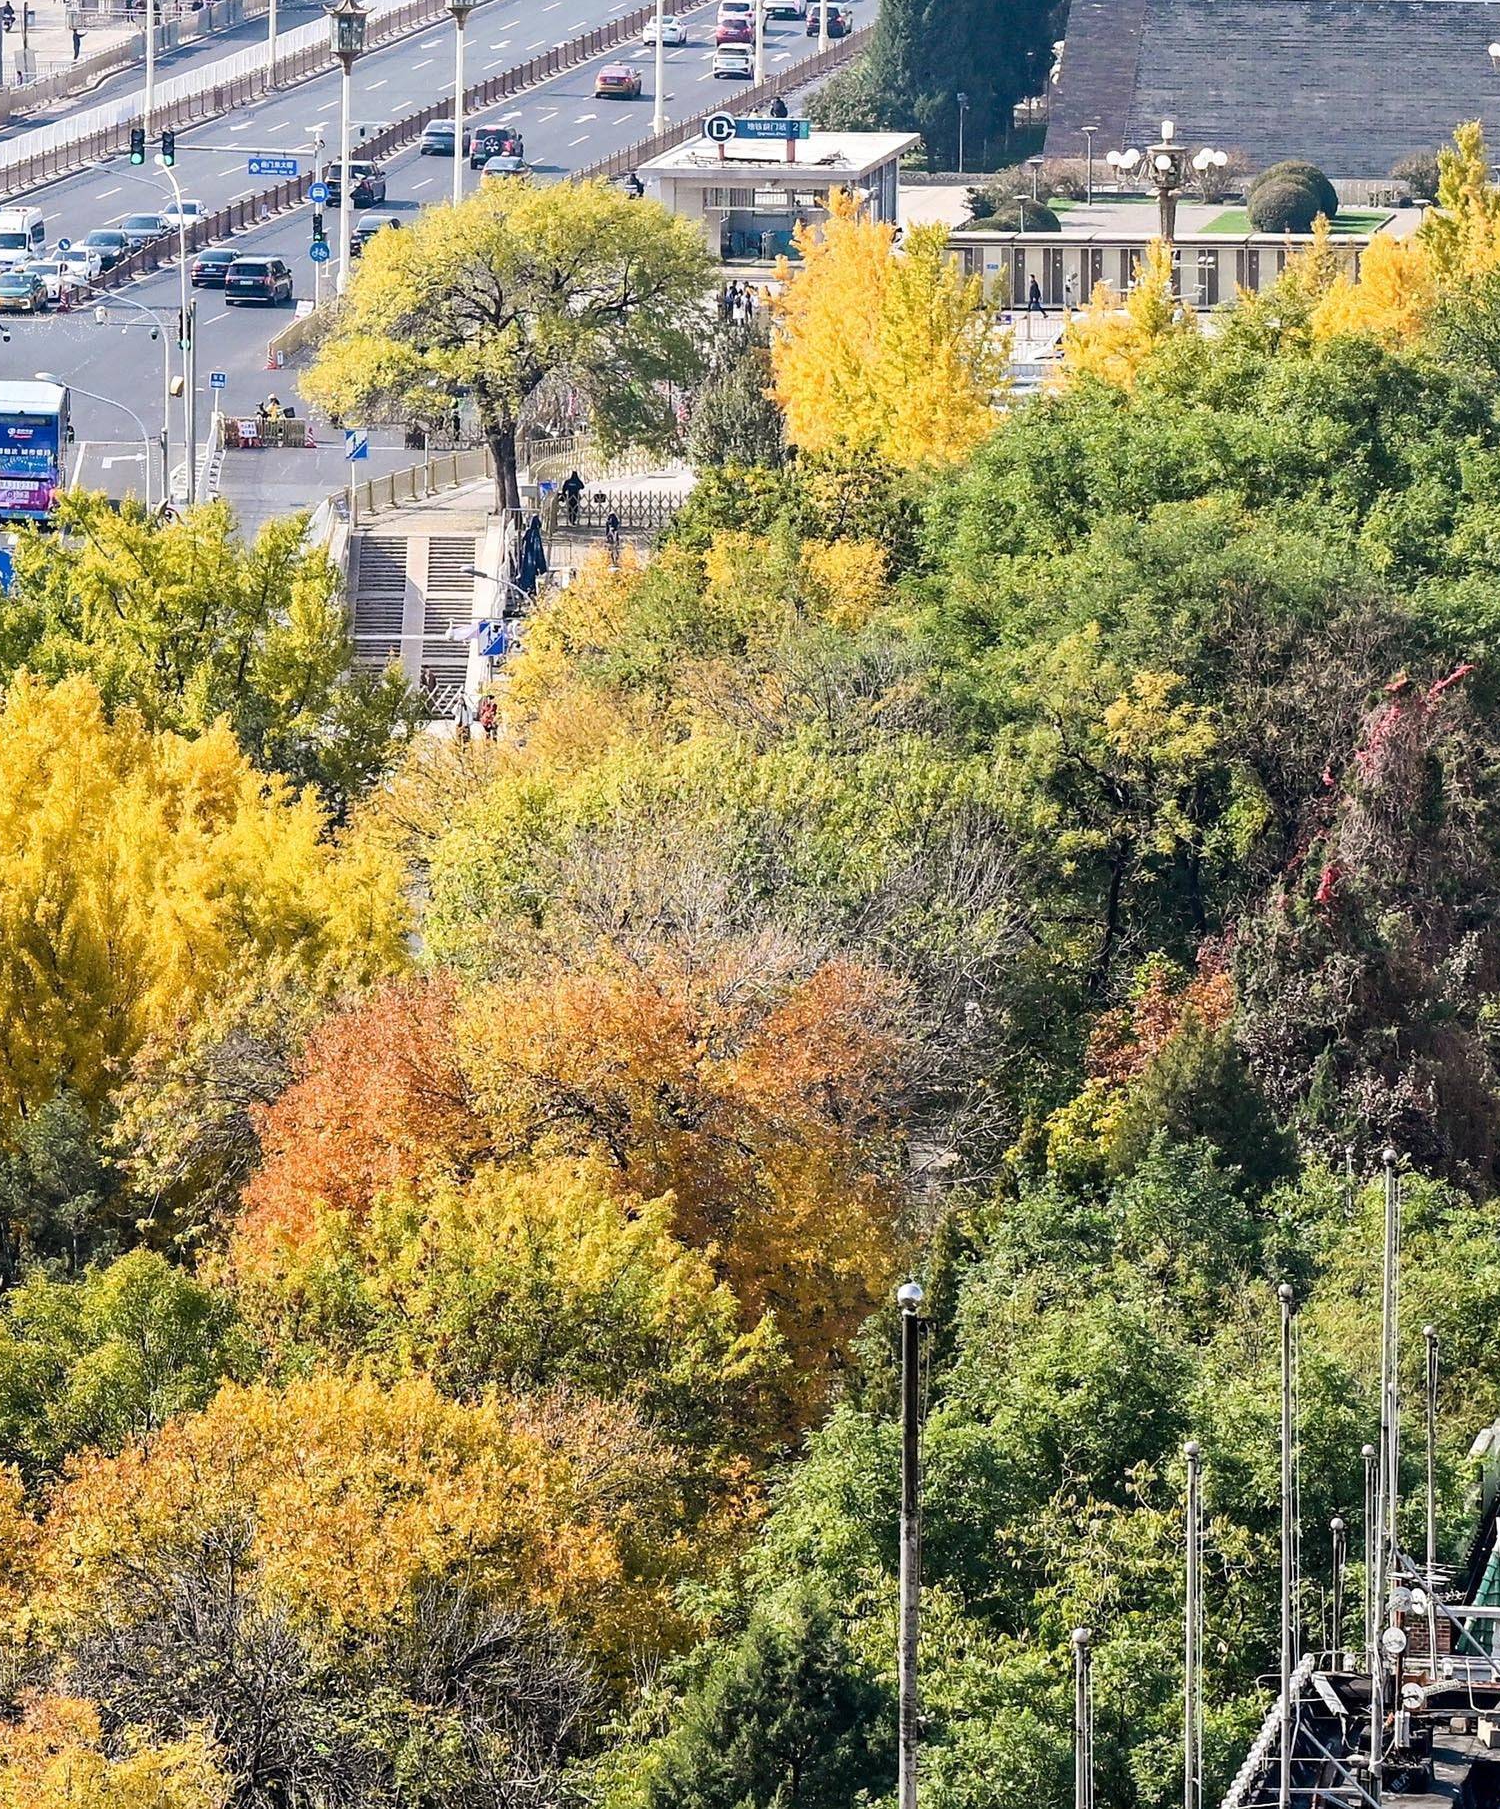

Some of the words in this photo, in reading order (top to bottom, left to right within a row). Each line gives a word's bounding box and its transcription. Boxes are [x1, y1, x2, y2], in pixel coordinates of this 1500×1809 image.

[747, 122, 787, 131] 地铁前门站
[792, 122, 799, 131] 2
